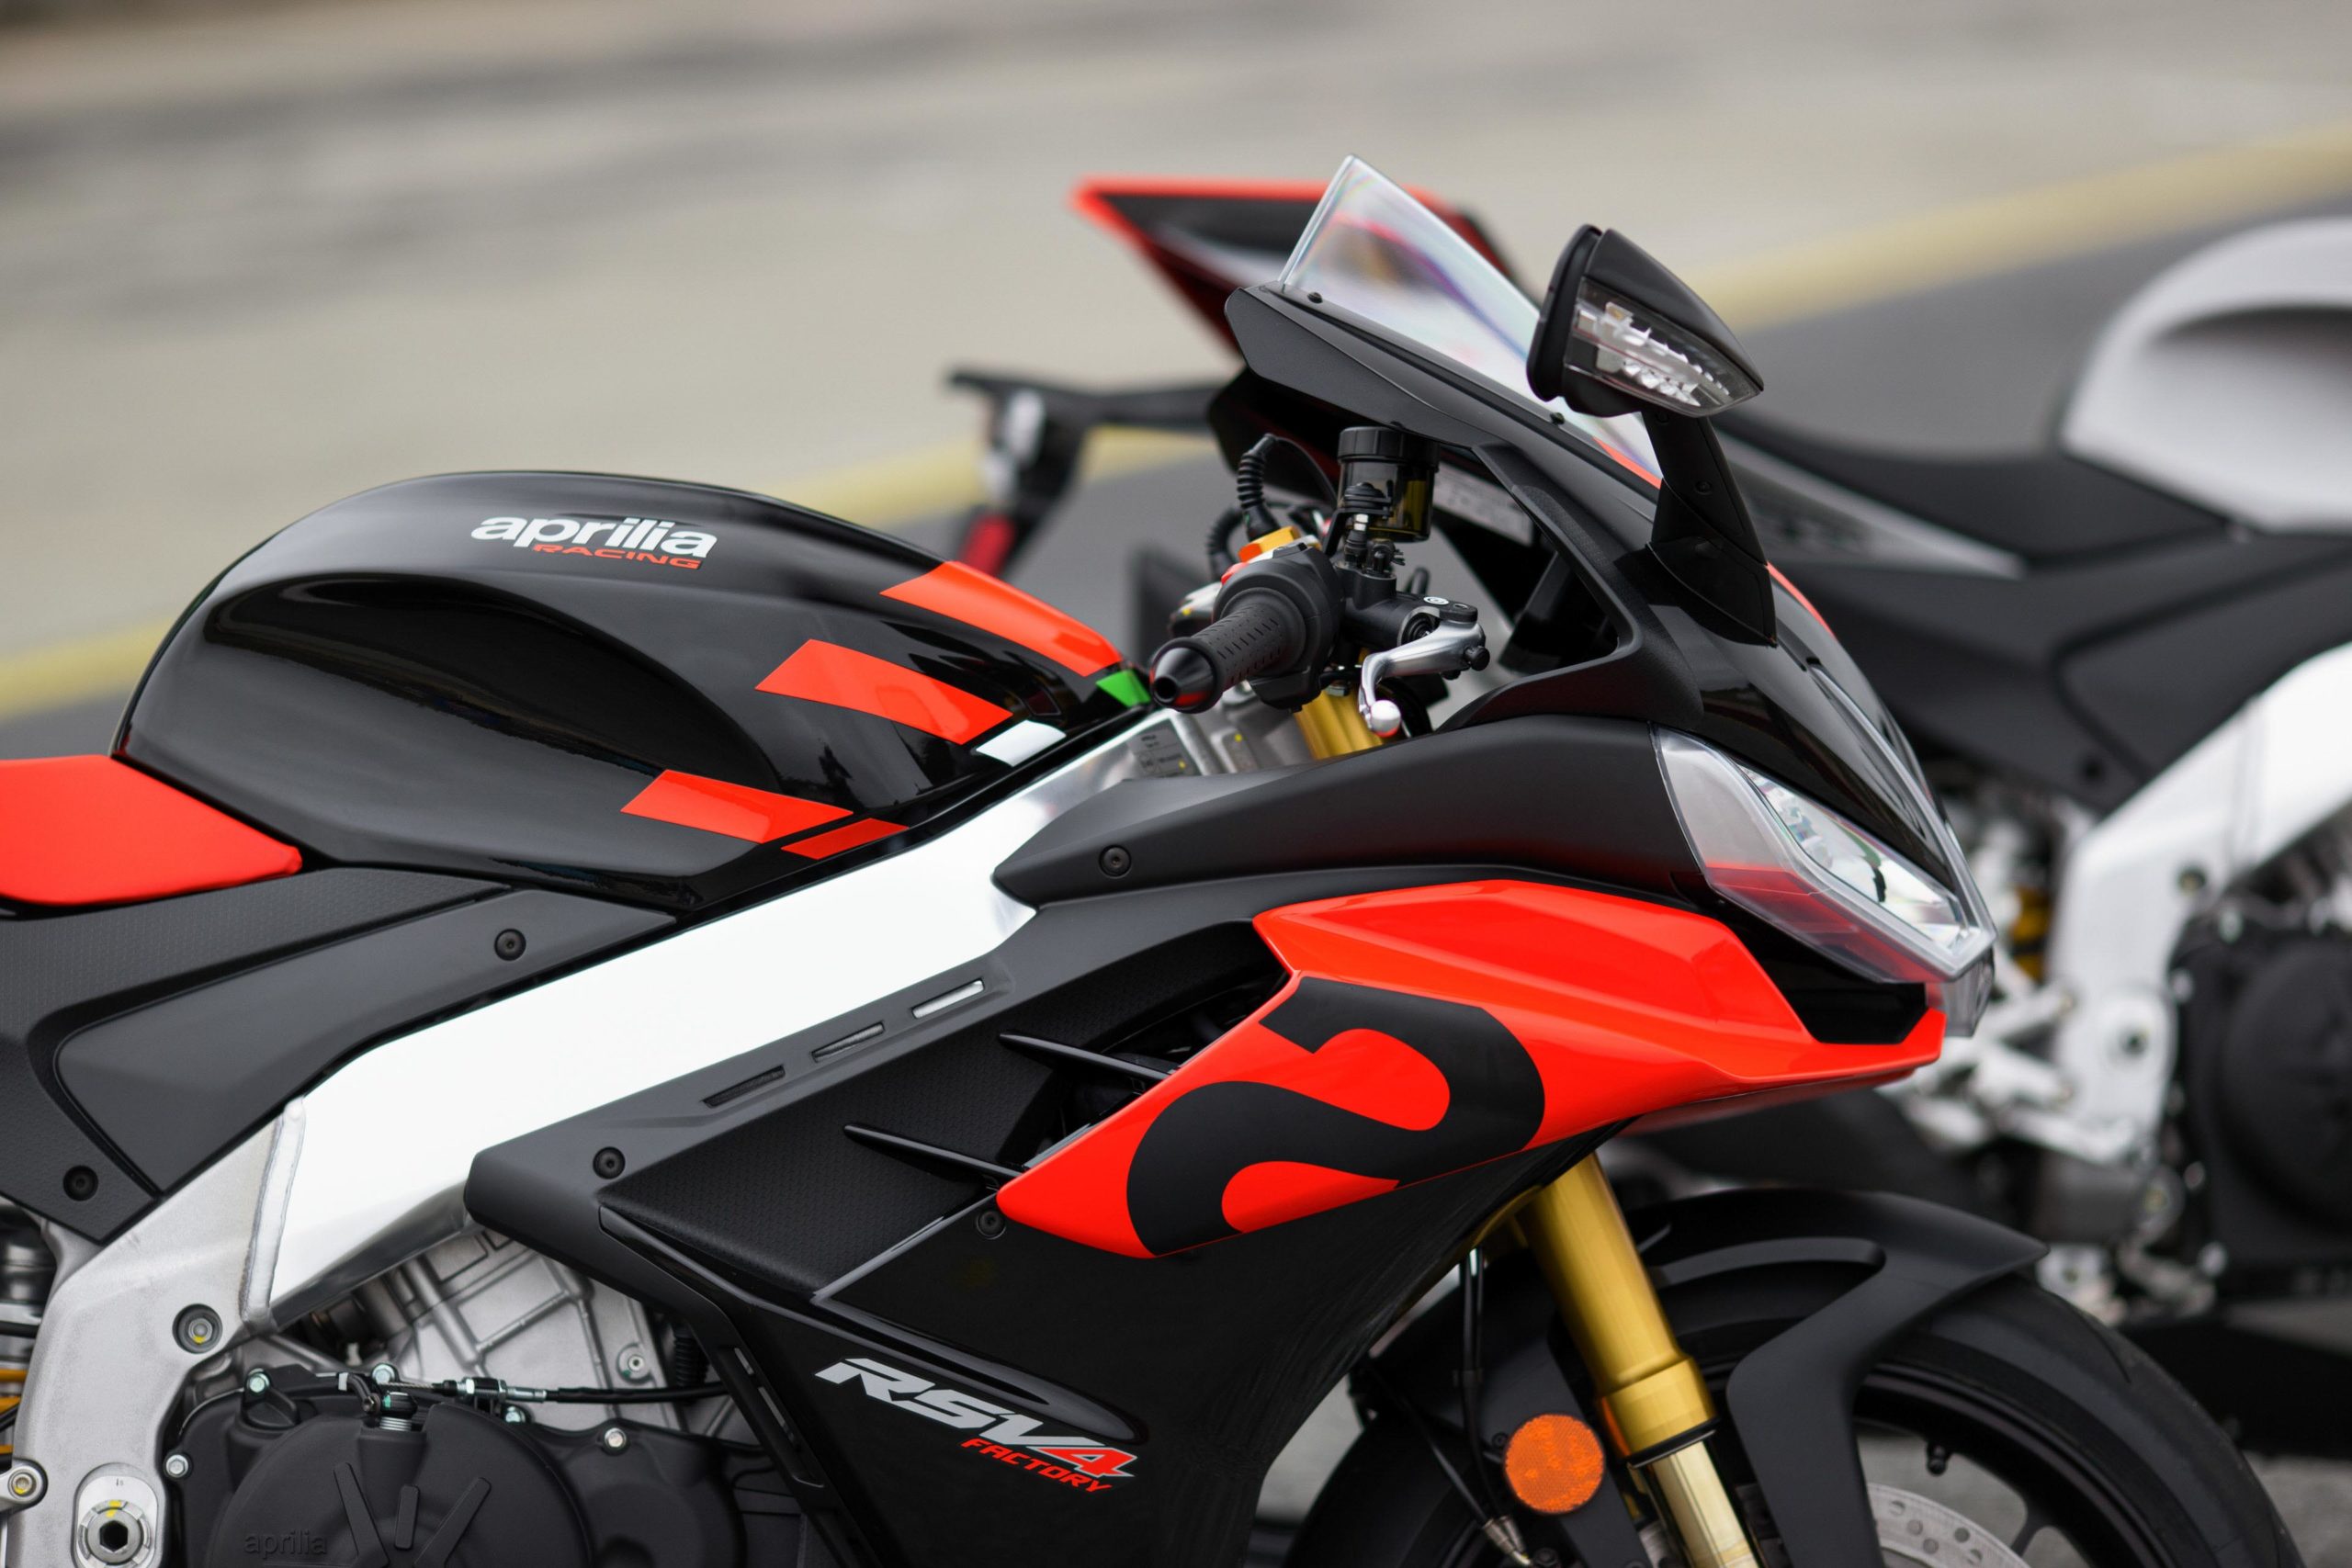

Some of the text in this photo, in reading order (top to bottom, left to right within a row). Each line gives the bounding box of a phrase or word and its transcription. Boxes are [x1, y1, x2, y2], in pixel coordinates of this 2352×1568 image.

[470, 516, 718, 558] aprilia
[532, 543, 704, 570] RACING
[814, 1358, 1138, 1478] RSV4
[961, 1438, 1113, 1493] FACTORY
[243, 1529, 328, 1559] aprilia
